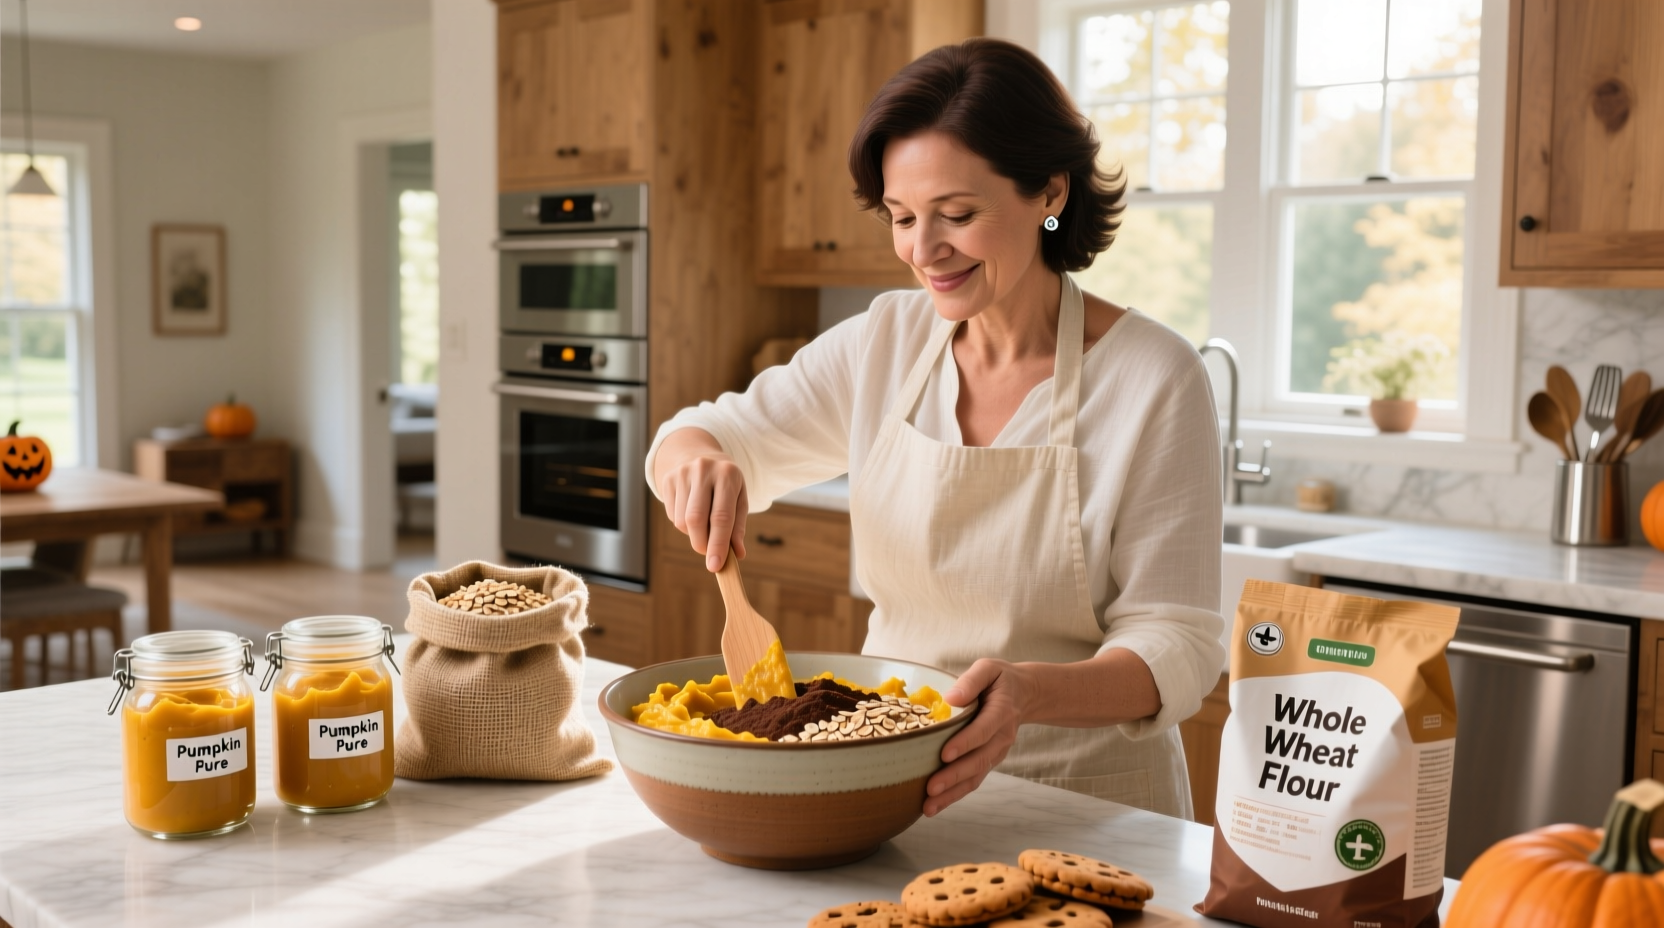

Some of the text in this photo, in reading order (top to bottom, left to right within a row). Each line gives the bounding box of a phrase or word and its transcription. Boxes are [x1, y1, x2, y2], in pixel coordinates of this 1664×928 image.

[1274, 693, 1366, 735] Whole
[319, 719, 378, 738] Pumpkin
[177, 738, 241, 759] Pumpkin
[336, 738, 368, 752] Pure
[1265, 725, 1358, 768] Wheat
[195, 759, 228, 773] Pure
[1258, 760, 1340, 802] Flour
